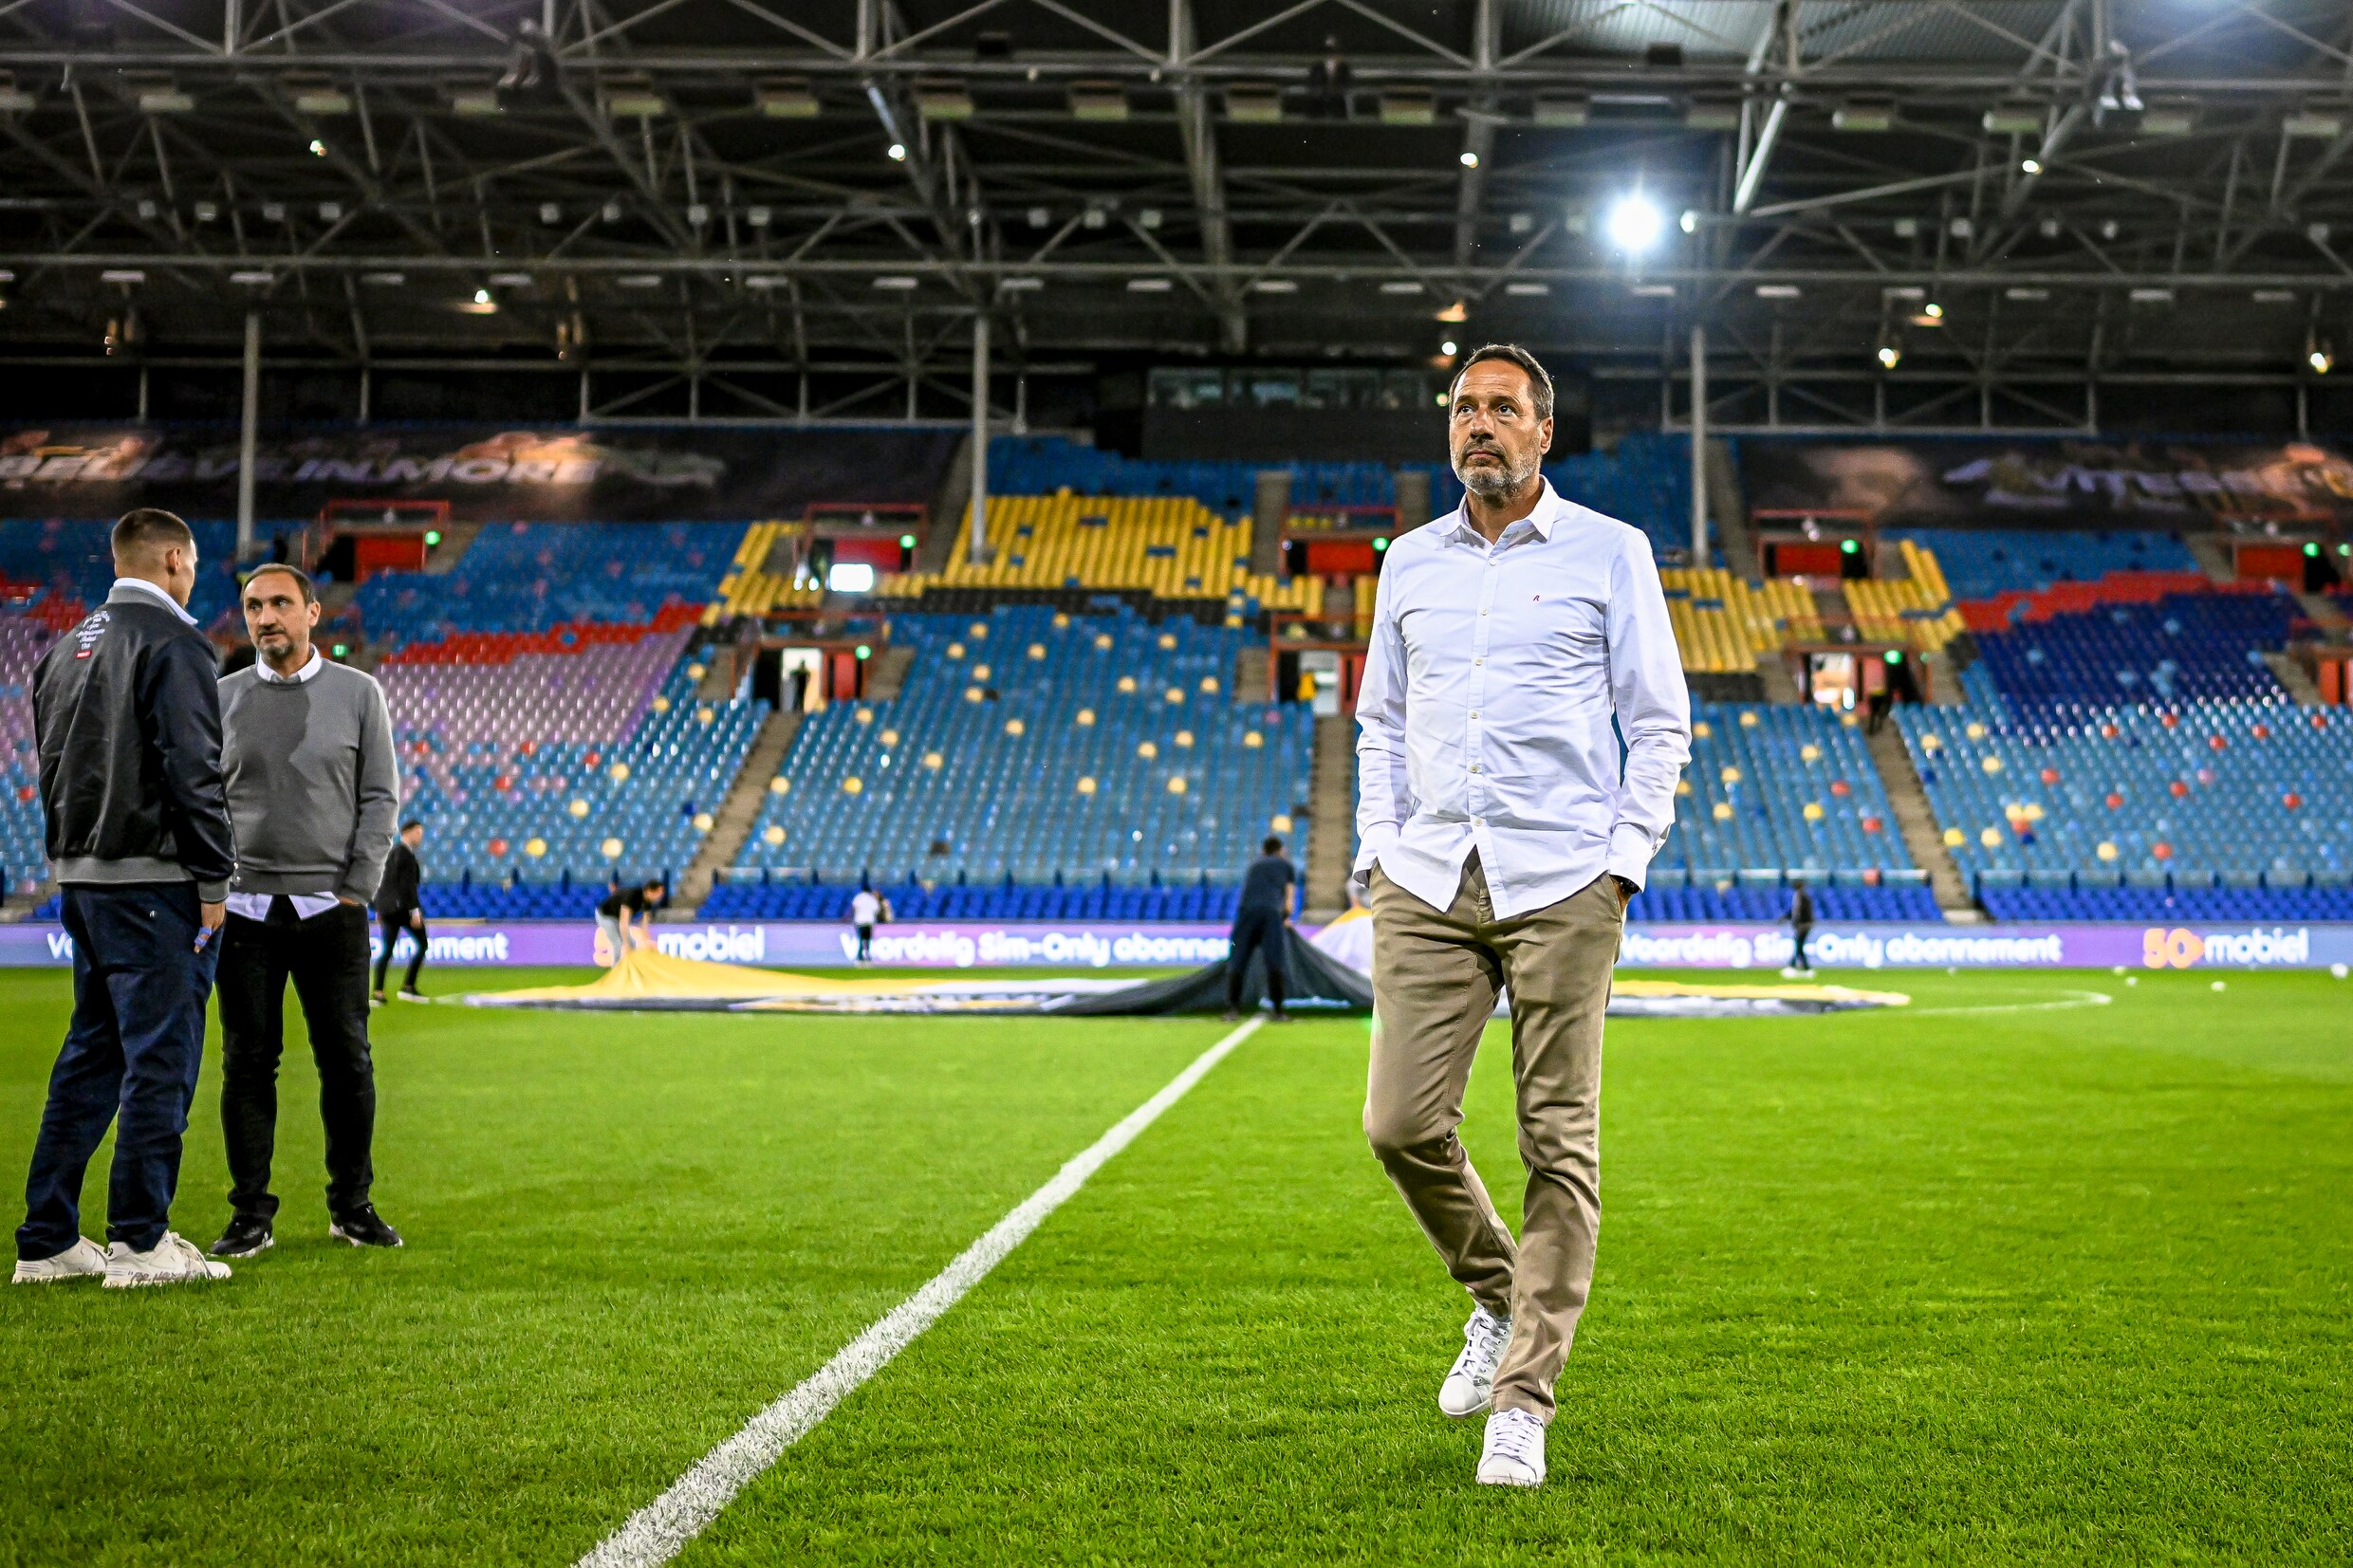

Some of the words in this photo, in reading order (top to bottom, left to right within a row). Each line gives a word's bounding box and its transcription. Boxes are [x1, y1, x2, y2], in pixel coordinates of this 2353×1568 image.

[658, 925, 765, 961] mobiel
[840, 931, 975, 967] Vordelig
[978, 931, 1110, 967] Sim-Only
[1113, 932, 1231, 962] abonne
[1885, 932, 2063, 962] abonnement
[2205, 927, 2308, 963] mobiel
